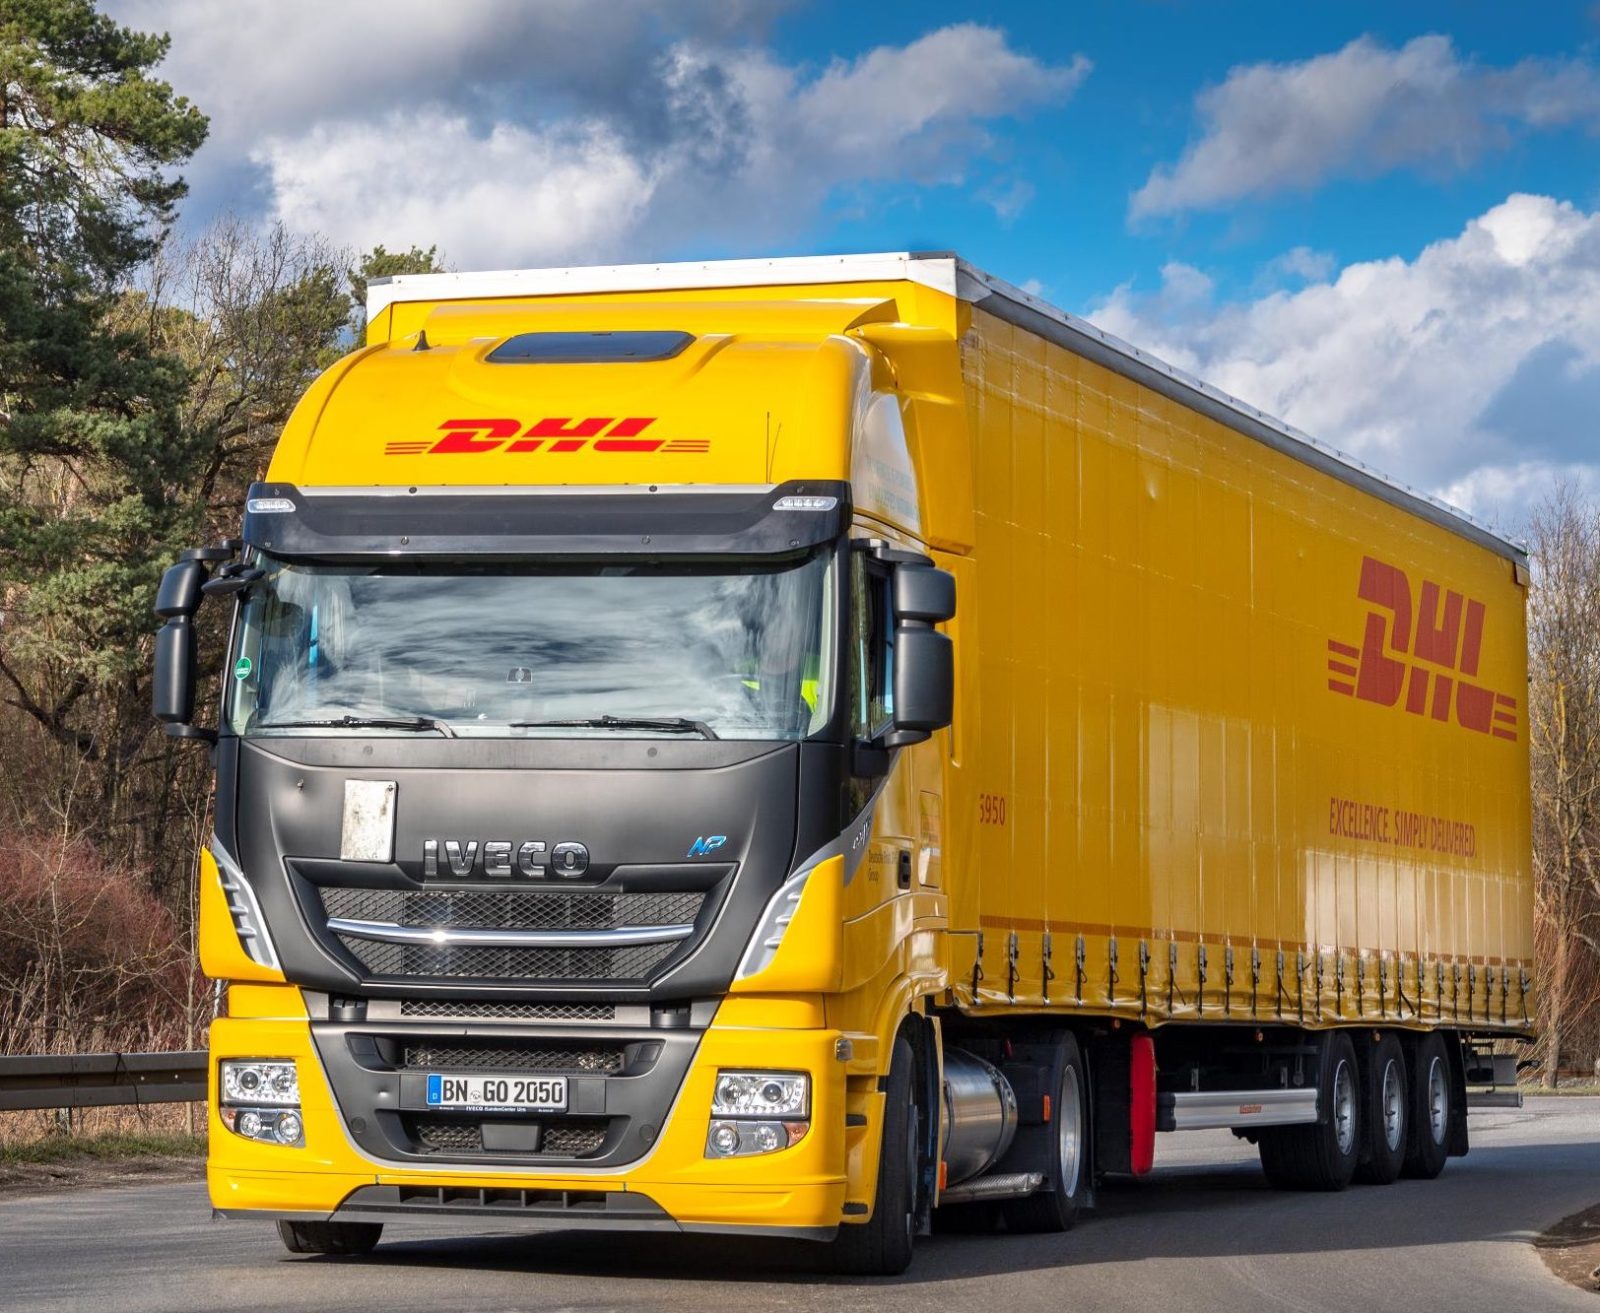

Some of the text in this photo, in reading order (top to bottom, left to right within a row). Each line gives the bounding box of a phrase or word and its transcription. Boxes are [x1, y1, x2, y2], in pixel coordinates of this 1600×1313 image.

[427, 418, 666, 454] DHL
[1356, 555, 1495, 734] DHL
[1330, 797, 1392, 844] EXCELLENCE.
[1394, 810, 1429, 849] SIMPLY
[423, 839, 591, 879] IVECO
[686, 835, 727, 858] NP
[443, 1079, 468, 1102] BN
[483, 1080, 508, 1103] GO
[513, 1081, 563, 1104] 2050
